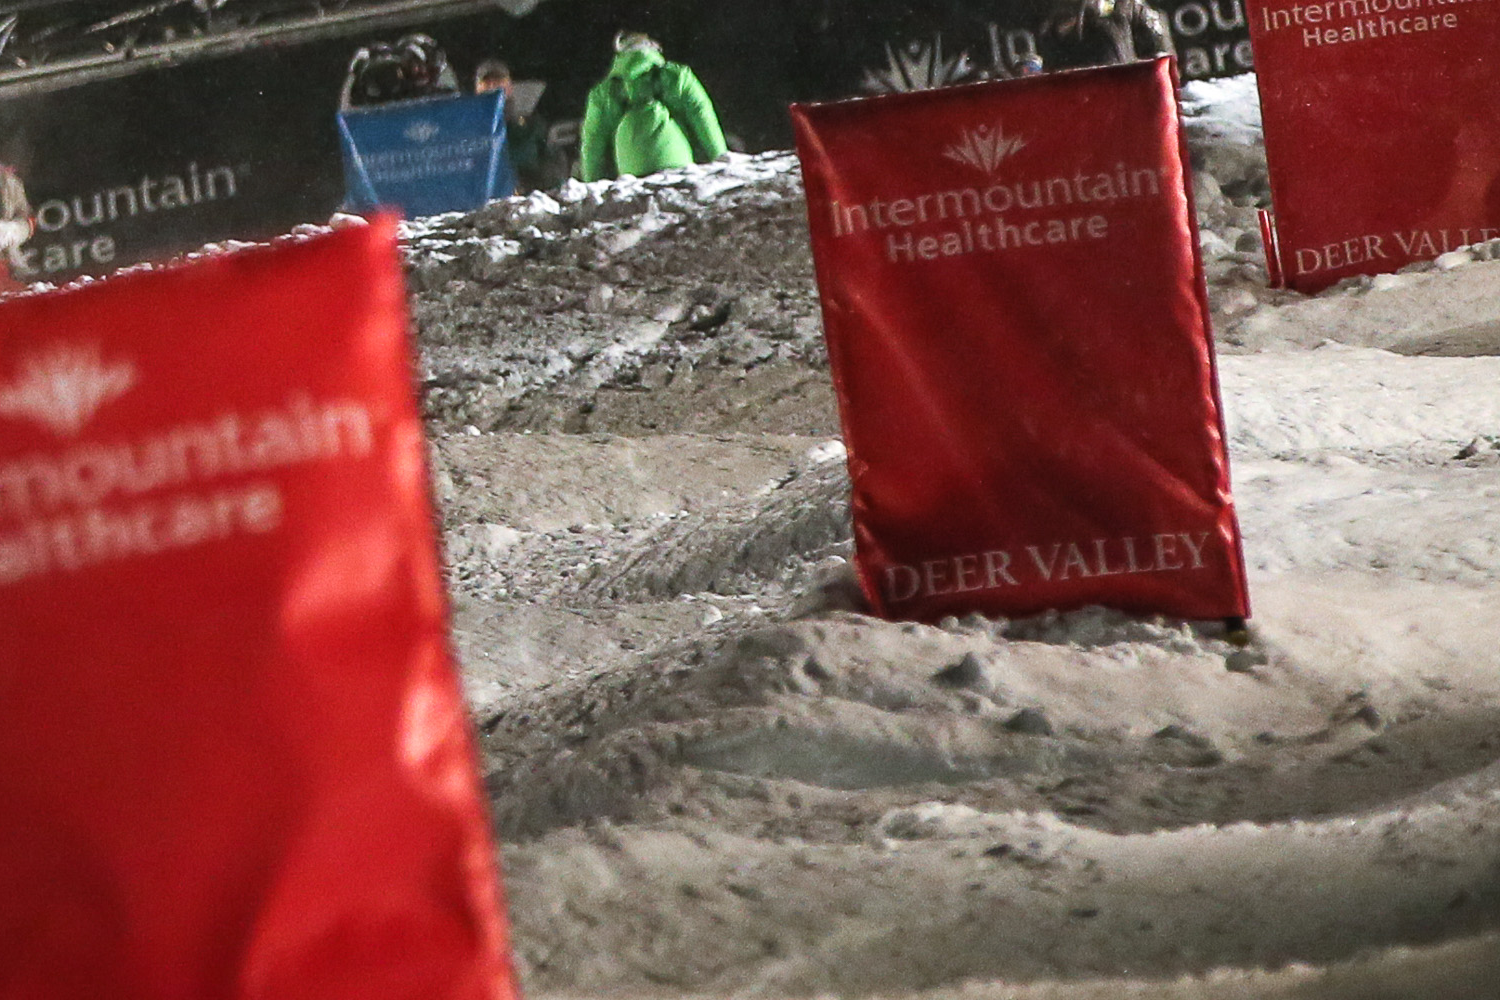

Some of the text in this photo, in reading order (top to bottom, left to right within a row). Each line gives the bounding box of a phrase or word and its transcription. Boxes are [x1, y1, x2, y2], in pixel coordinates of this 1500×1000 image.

[1302, 12, 1459, 48] Healthcare
[830, 161, 1160, 238] Intermountain
[886, 213, 1110, 264] Healthcare
[1295, 234, 1390, 275] DEER
[884, 531, 1211, 601] DEER VALLEY
